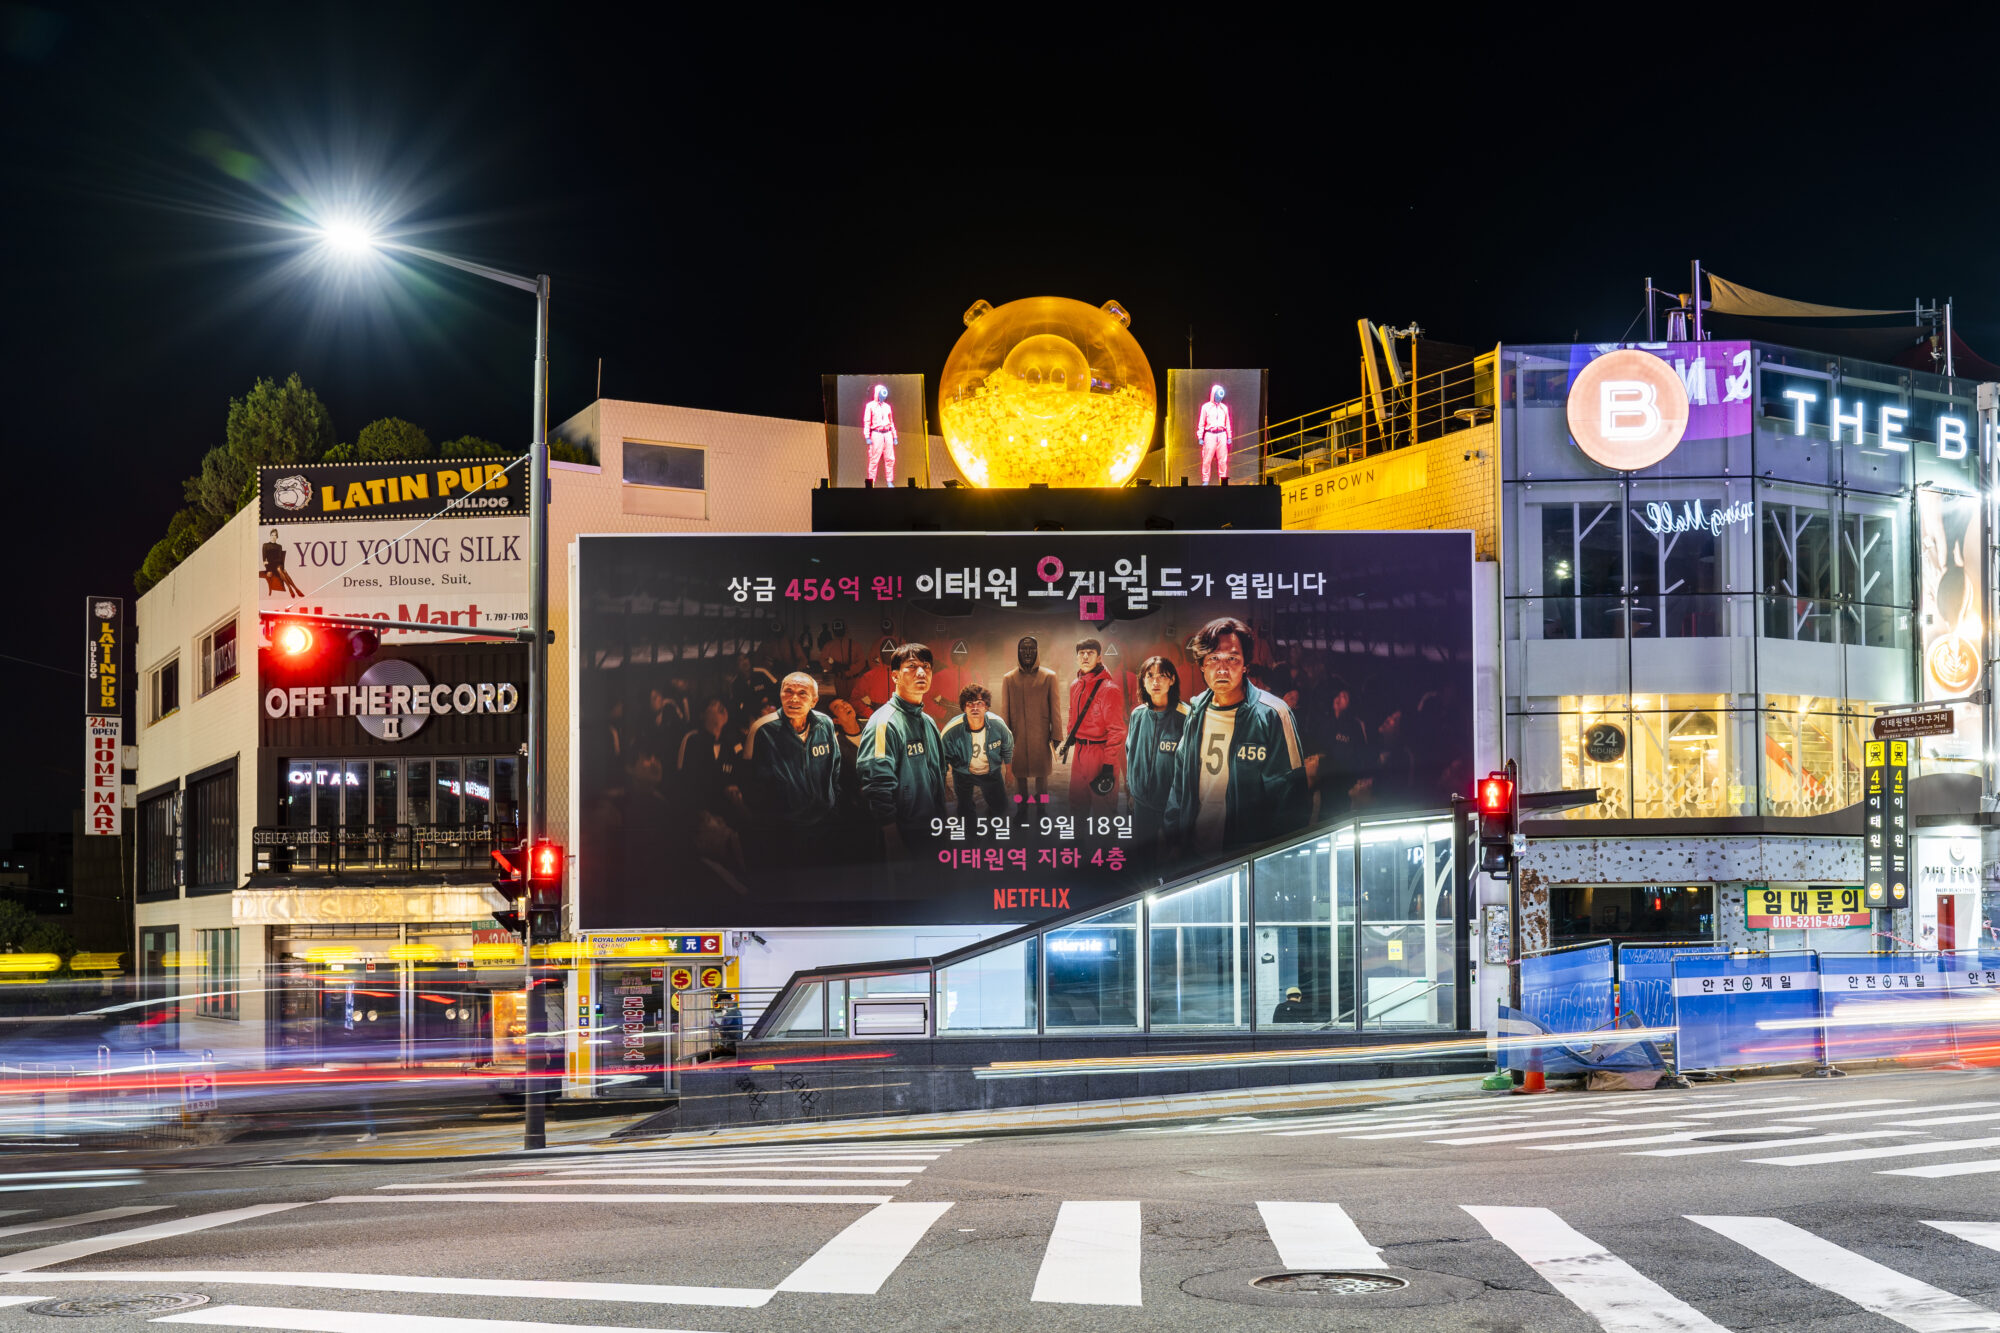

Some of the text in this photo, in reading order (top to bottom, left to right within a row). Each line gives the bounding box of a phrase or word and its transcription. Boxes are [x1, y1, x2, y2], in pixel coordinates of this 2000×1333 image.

[1600, 380, 1661, 441] B
[1782, 389, 1910, 453] THE
[321, 463, 510, 512] LATIN PUB
[1314, 469, 1375, 498] BROWN
[446, 496, 510, 510] BULLDOG
[293, 534, 523, 568] YOU YOUNG SILK
[342, 573, 472, 589] Dress. Blouse. Suit.
[727, 576, 777, 603] 상금
[784, 576, 860, 602] 456억
[870, 575, 903, 601] 원!
[915, 566, 1018, 608] 이태원
[1225, 571, 1328, 600] 열립니다
[397, 603, 484, 636] Mart
[493, 612, 529, 622] 797-1703
[89, 640, 98, 679] BULLDOG
[98, 621, 117, 708] LATIN PUB
[265, 682, 520, 719] OFF THE RECORD
[89, 716, 120, 728] 24hrs
[382, 717, 401, 738] II
[1880, 712, 1949, 728] 이태원앤틱가구거리
[92, 727, 117, 736] OPEN
[1592, 731, 1619, 748] 24
[812, 743, 831, 758] 001
[907, 742, 925, 757] 218
[1159, 740, 1178, 753] 067
[1237, 745, 1267, 762] 456
[1590, 747, 1620, 755] HOURS
[93, 737, 115, 788] HOME
[1870, 769, 1881, 785] 4
[1894, 769, 1904, 785] 4
[930, 816, 966, 841] 9월
[975, 815, 1011, 840] 5일
[1039, 815, 1076, 840] 9월
[1086, 815, 1133, 839] 18일
[1869, 795, 1882, 848] 이태원
[1893, 795, 1905, 848] 이태원
[253, 830, 289, 846] STELLA
[296, 829, 330, 845] ARTOIS
[414, 826, 493, 844] Hoegaarden
[938, 847, 1127, 872] 이태원역 지하 4층
[993, 888, 1071, 910] NETFLIX
[1763, 889, 1860, 915] 임대문의
[1772, 914, 1851, 929] 010-5216-4342
[685, 938, 697, 950] 元
[1702, 975, 1792, 993] 안전 제일
[1848, 975, 1925, 988] 안전 제일
[1968, 971, 1997, 985] 안전
